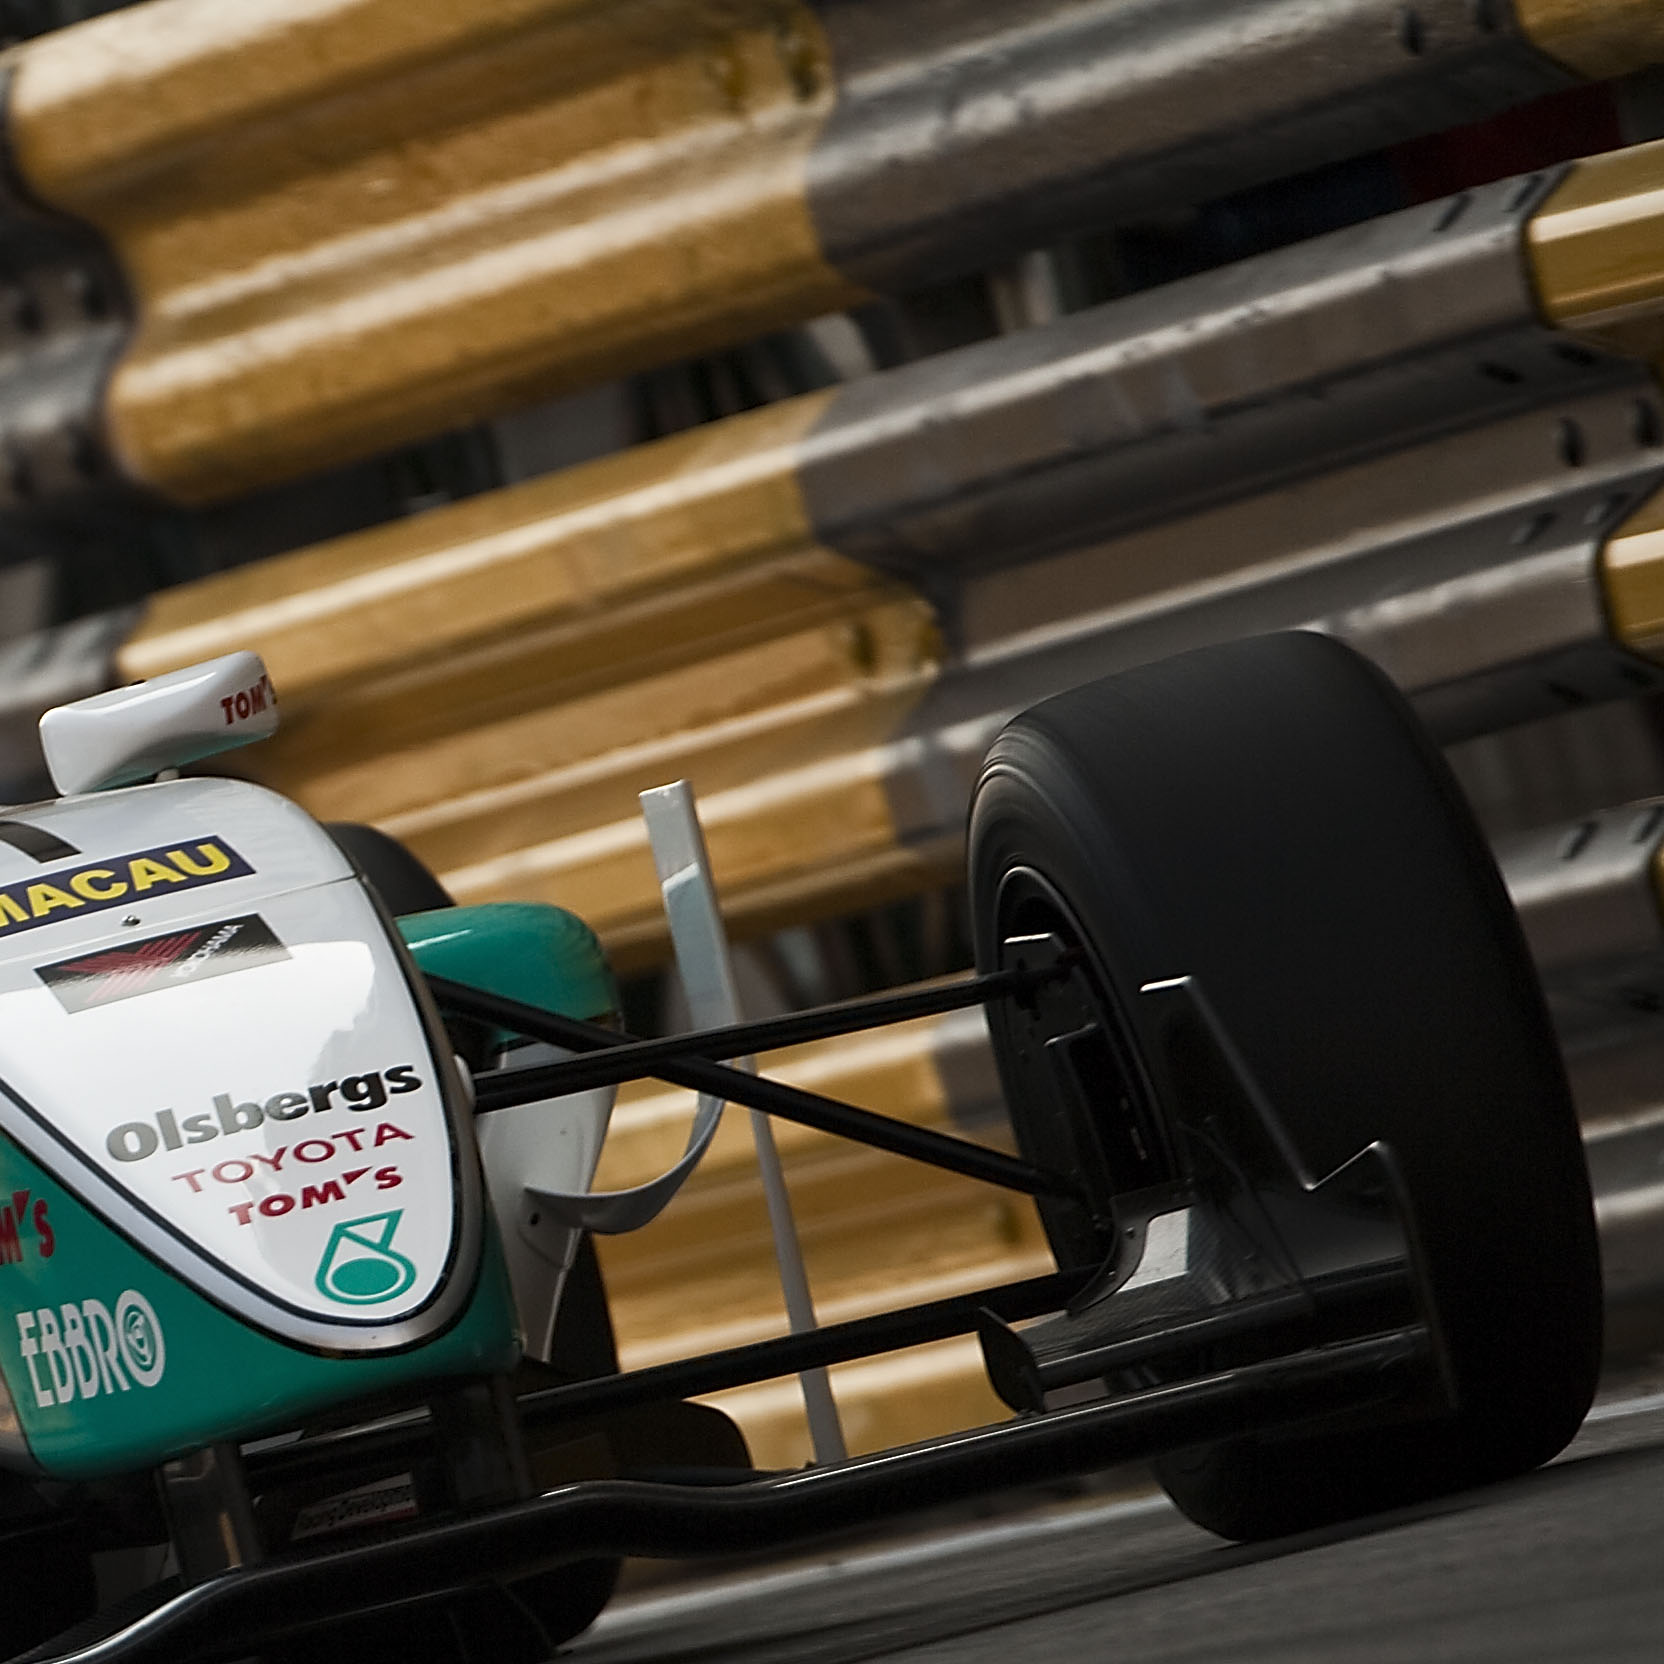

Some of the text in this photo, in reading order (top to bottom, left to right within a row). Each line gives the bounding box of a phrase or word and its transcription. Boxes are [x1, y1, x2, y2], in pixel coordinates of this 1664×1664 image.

[106, 1065, 422, 1162] Olsbergs
[172, 1122, 416, 1193] TOYOTA
[228, 1166, 404, 1226] TOM'S
[15, 1289, 166, 1408] EBBRO
